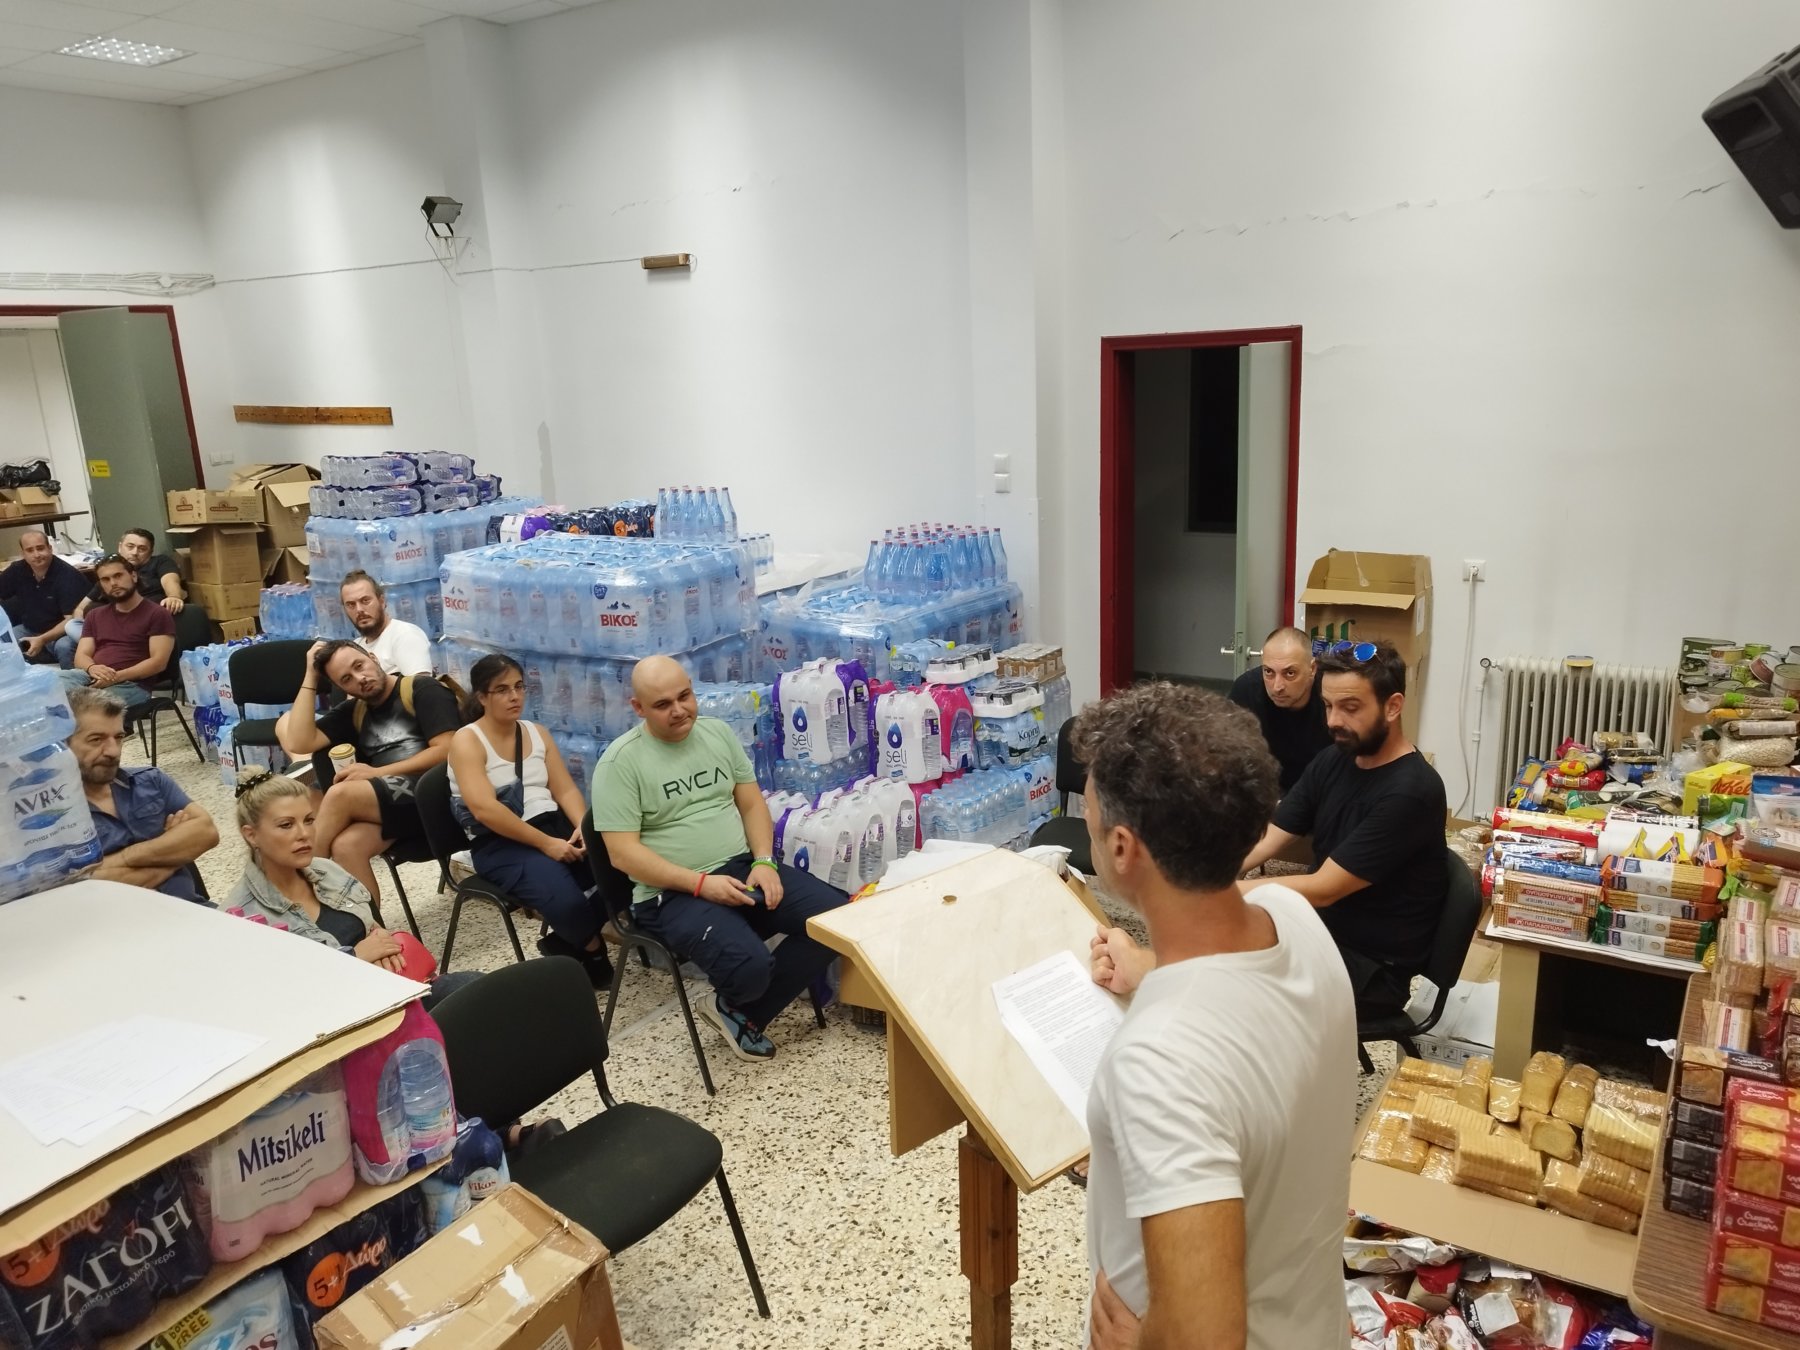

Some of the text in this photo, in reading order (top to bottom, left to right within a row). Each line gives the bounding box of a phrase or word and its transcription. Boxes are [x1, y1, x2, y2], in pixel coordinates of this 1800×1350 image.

[395, 547, 423, 561] ΒΙΚΟΣ
[600, 613, 638, 627] ΒΙΚΟΣ
[237, 1111, 327, 1183] Mitsikeli
[313, 1263, 343, 1300] 5+1
[177, 1314, 210, 1350] FREE
